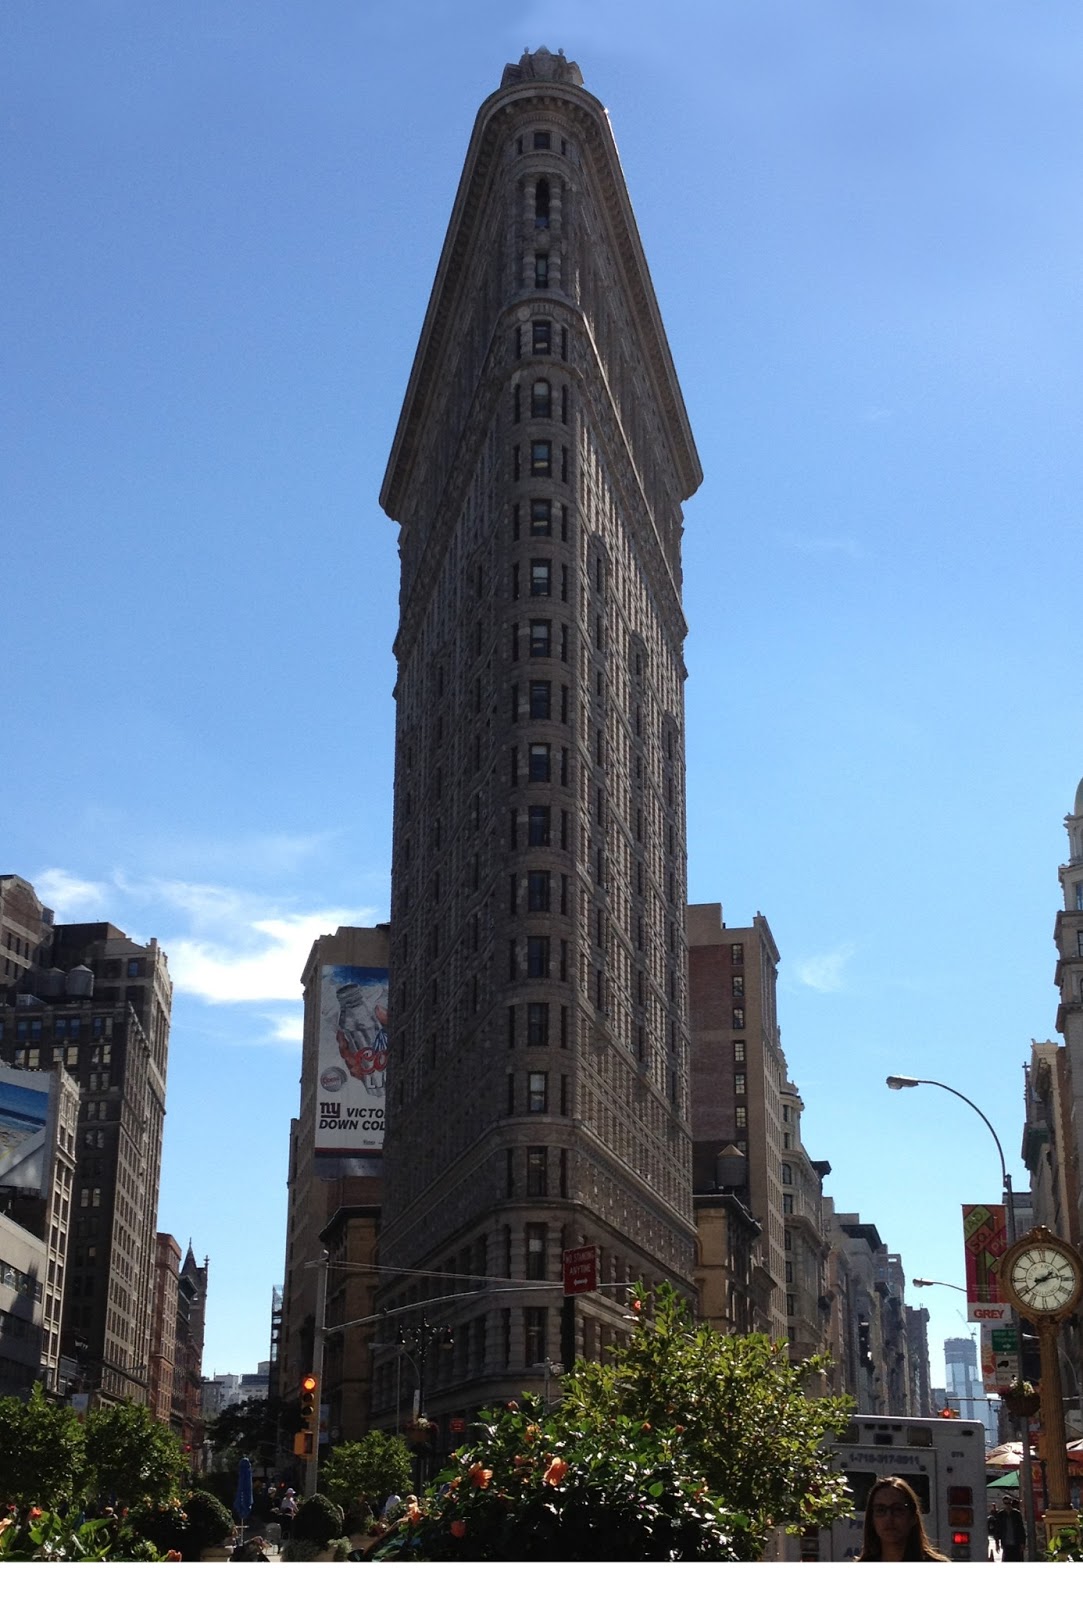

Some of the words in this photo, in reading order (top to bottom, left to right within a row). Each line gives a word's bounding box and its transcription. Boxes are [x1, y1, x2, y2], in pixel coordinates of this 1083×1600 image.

[346, 1108, 385, 1119] VICTO
[319, 1120, 359, 1130] DOWN
[973, 1308, 1005, 1319] GREY
